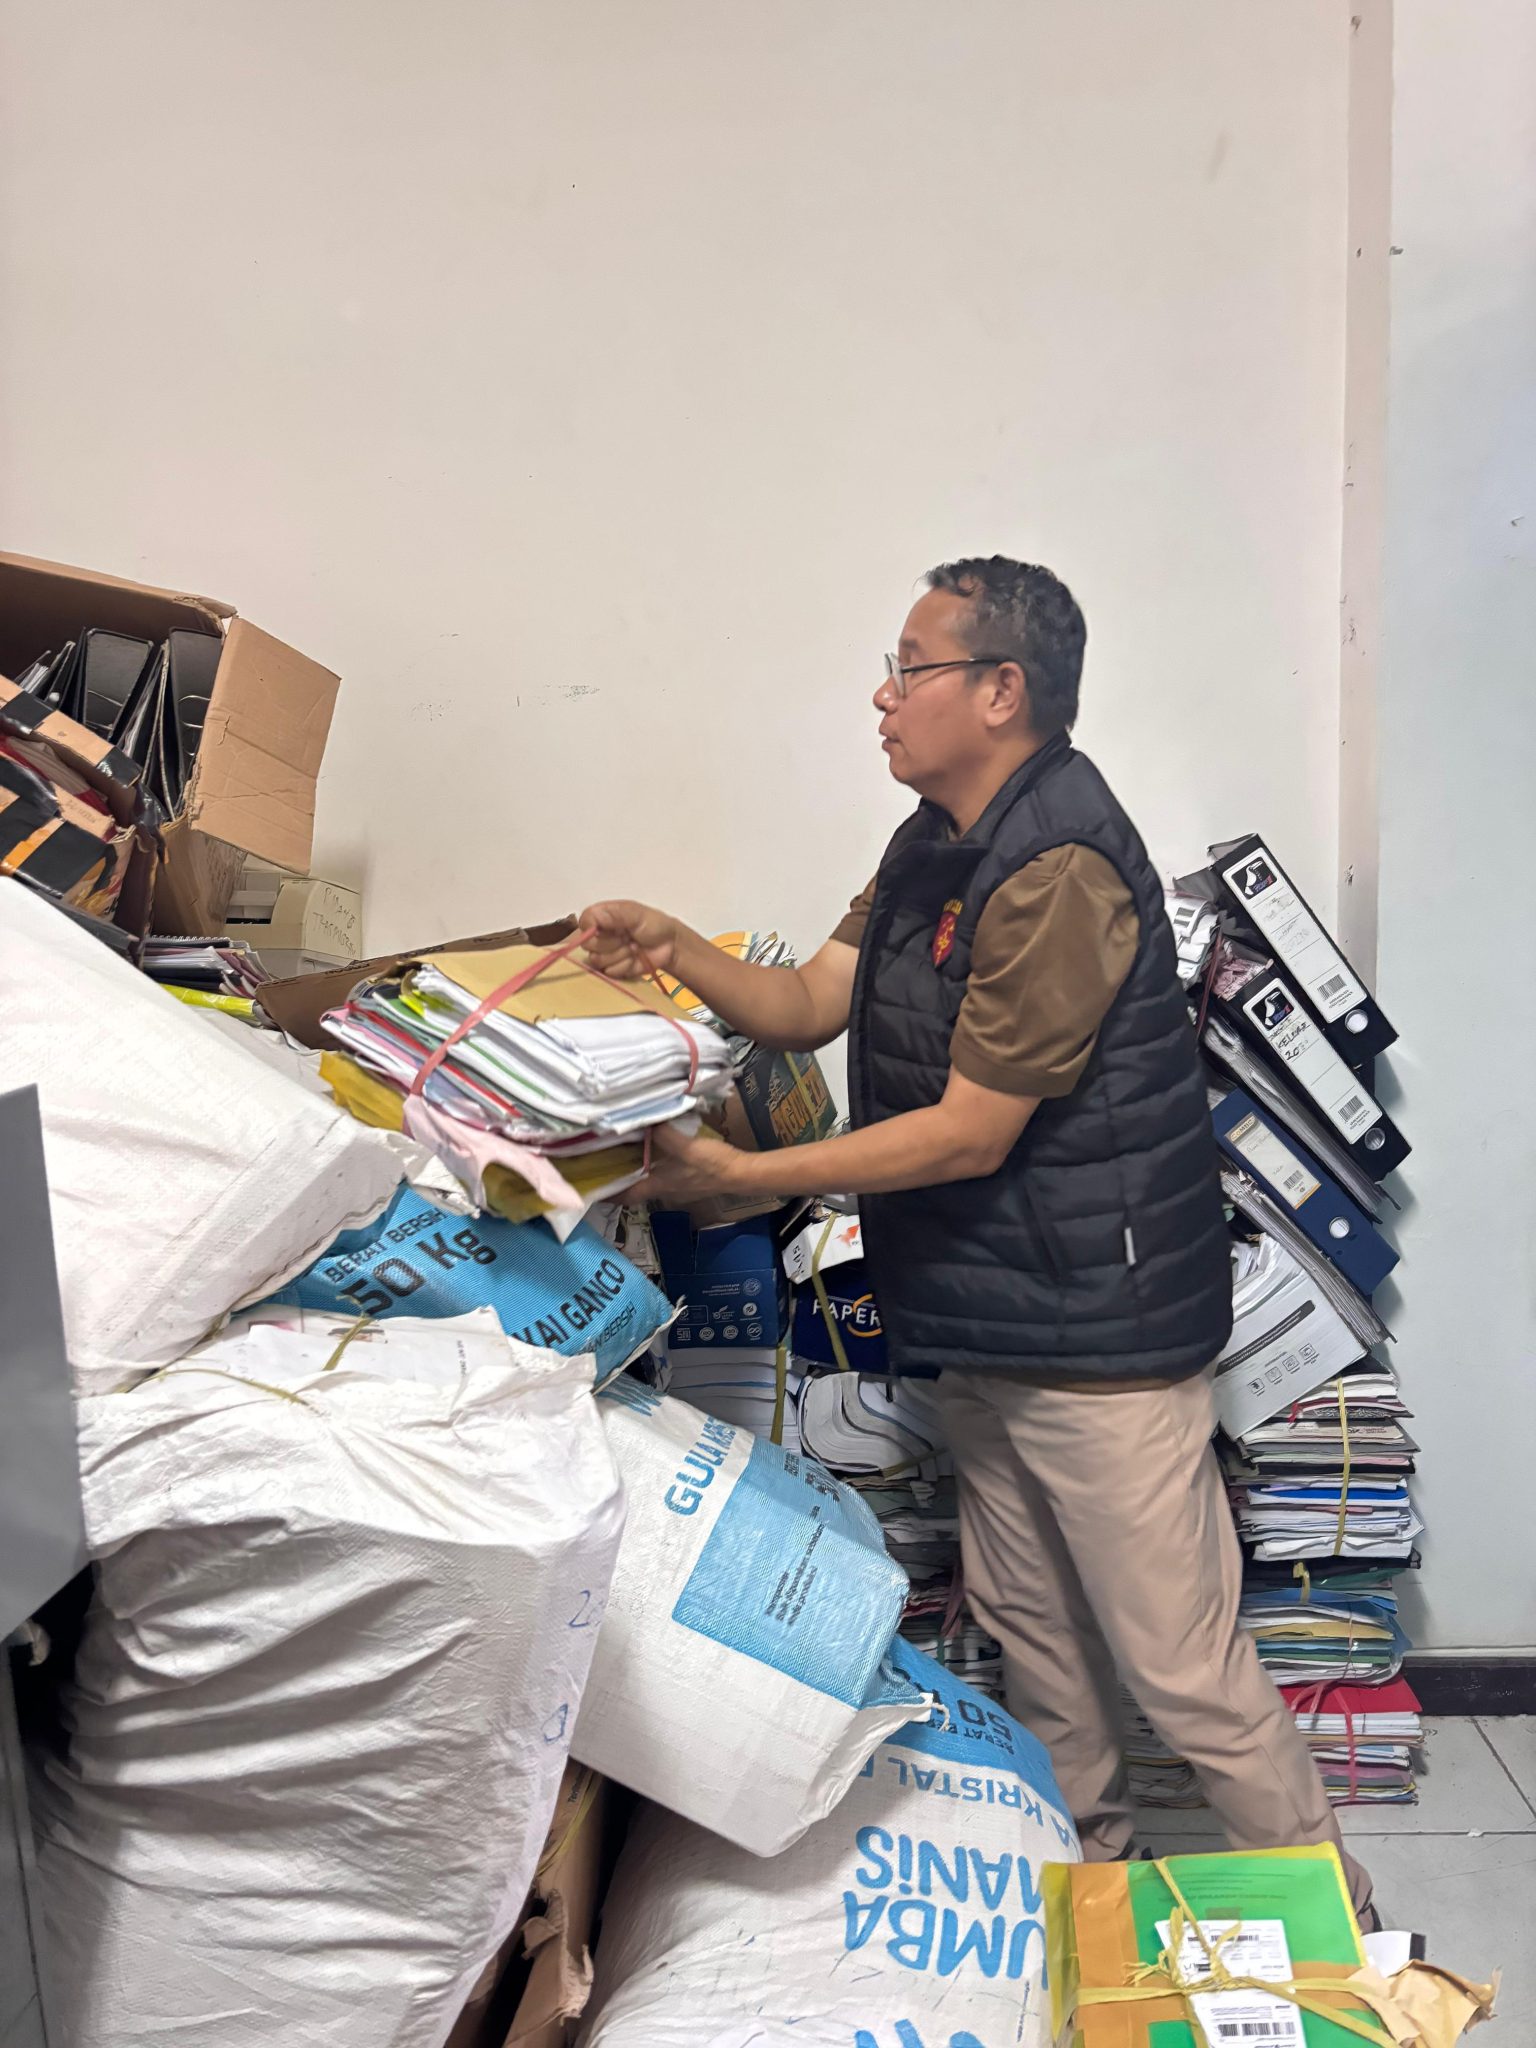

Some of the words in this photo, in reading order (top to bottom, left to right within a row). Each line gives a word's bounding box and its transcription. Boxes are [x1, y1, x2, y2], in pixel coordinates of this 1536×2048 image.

[324, 1241, 387, 1283] BERAT
[340, 1258, 426, 1316] 50
[415, 1227, 497, 1270] Kg
[560, 1258, 625, 1330] GANCO
[957, 1699, 1014, 1743] 50
[888, 1757, 1044, 1827] KRISTAL
